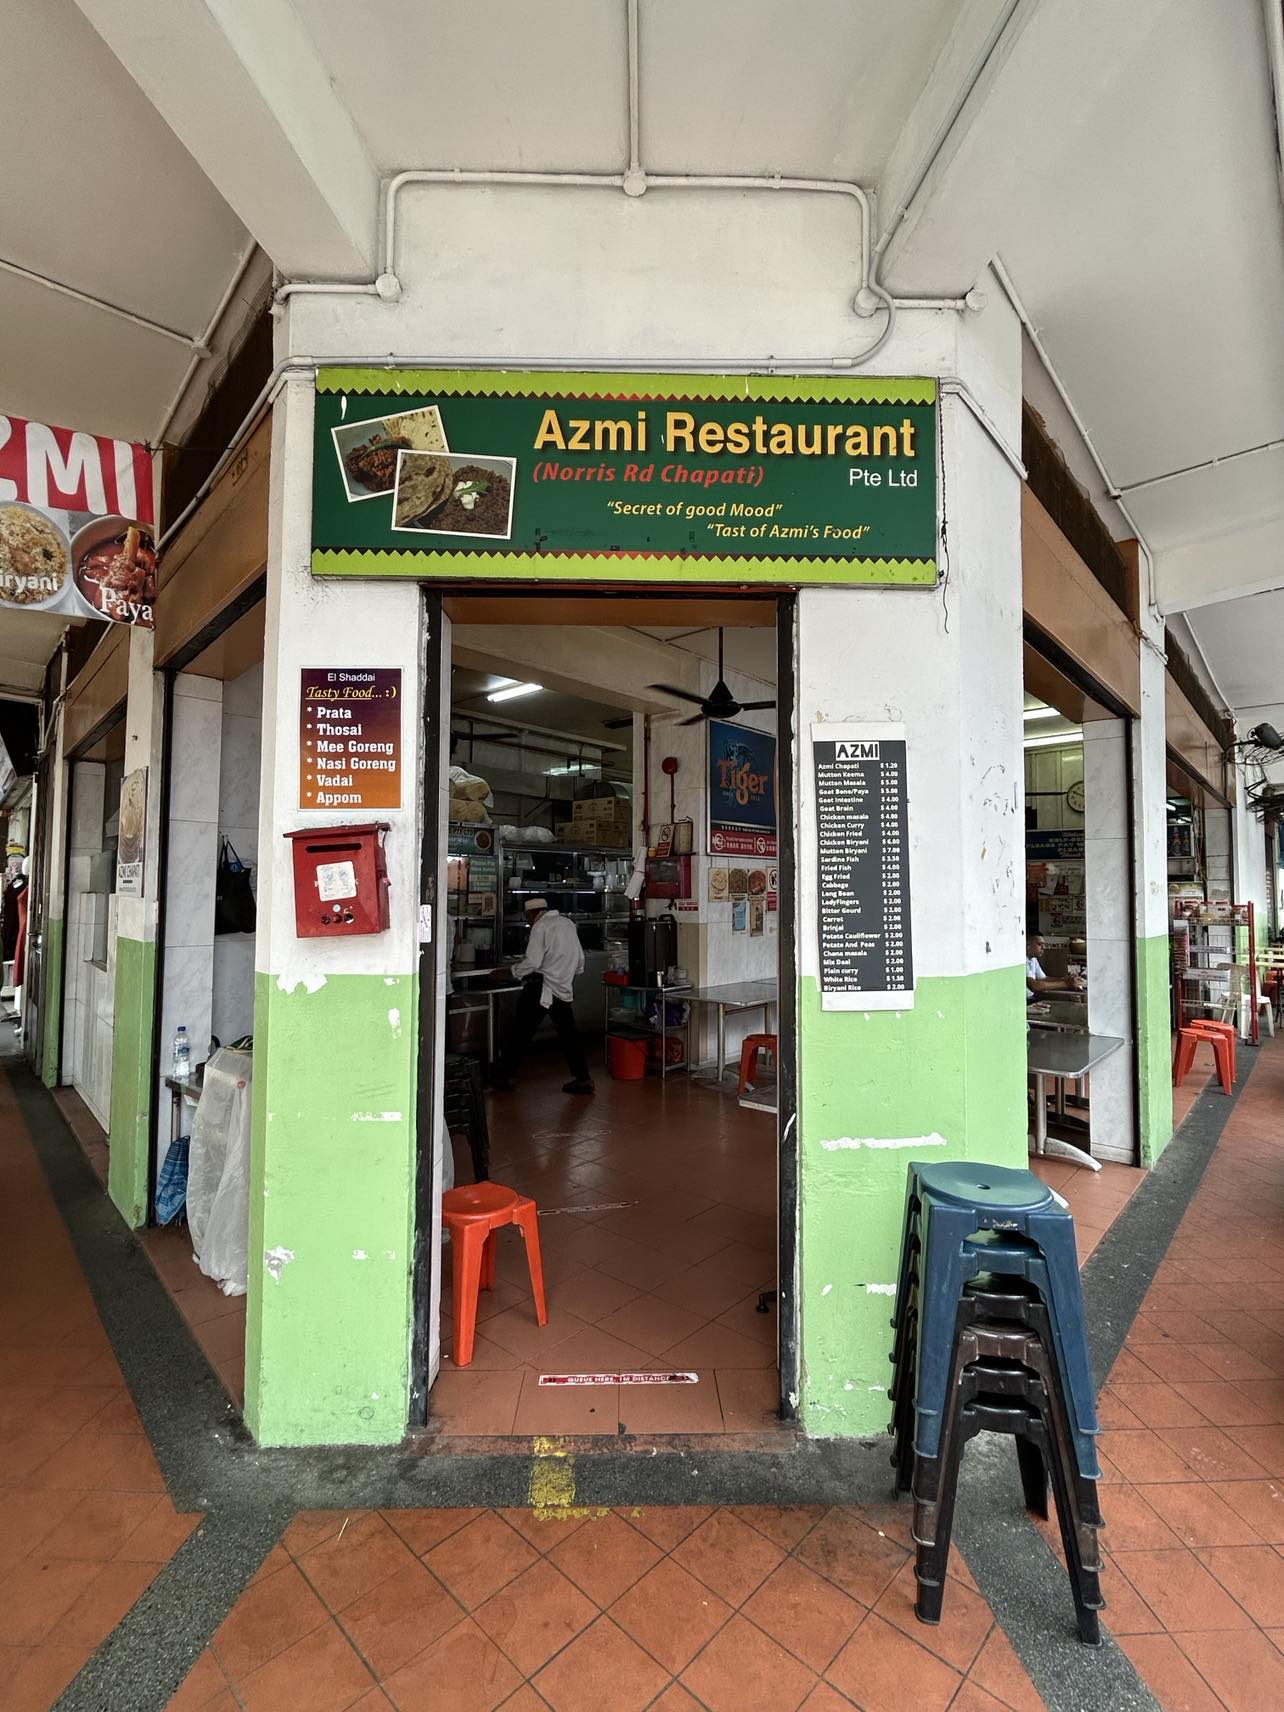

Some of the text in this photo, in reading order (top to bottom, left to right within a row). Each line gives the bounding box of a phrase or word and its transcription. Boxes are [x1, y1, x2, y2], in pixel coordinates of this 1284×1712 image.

[533, 409, 915, 457] Azmi Restaurant
[532, 462, 765, 488] (Norris Rd Chapati)
[850, 469, 918, 487] Pte Ltd
[607, 501, 783, 519] “Secret of good Mood”
[706, 524, 742, 538] “Tast
[746, 524, 767, 538] of
[100, 588, 154, 624] Paya
[327, 673, 376, 682] El Shaddai
[306, 685, 340, 701] Tasty
[342, 685, 382, 699] Food...
[317, 707, 352, 719] Prata
[317, 723, 362, 735] Thosai
[317, 741, 393, 754] Mee Goreng
[837, 744, 878, 758] AZMI
[317, 758, 396, 771] Nasi Goreng
[317, 774, 353, 786] Vadai
[717, 759, 768, 805] Tiger
[316, 792, 362, 806] Appom
[822, 873, 833, 881] Egg
[833, 873, 850, 881] Fried
